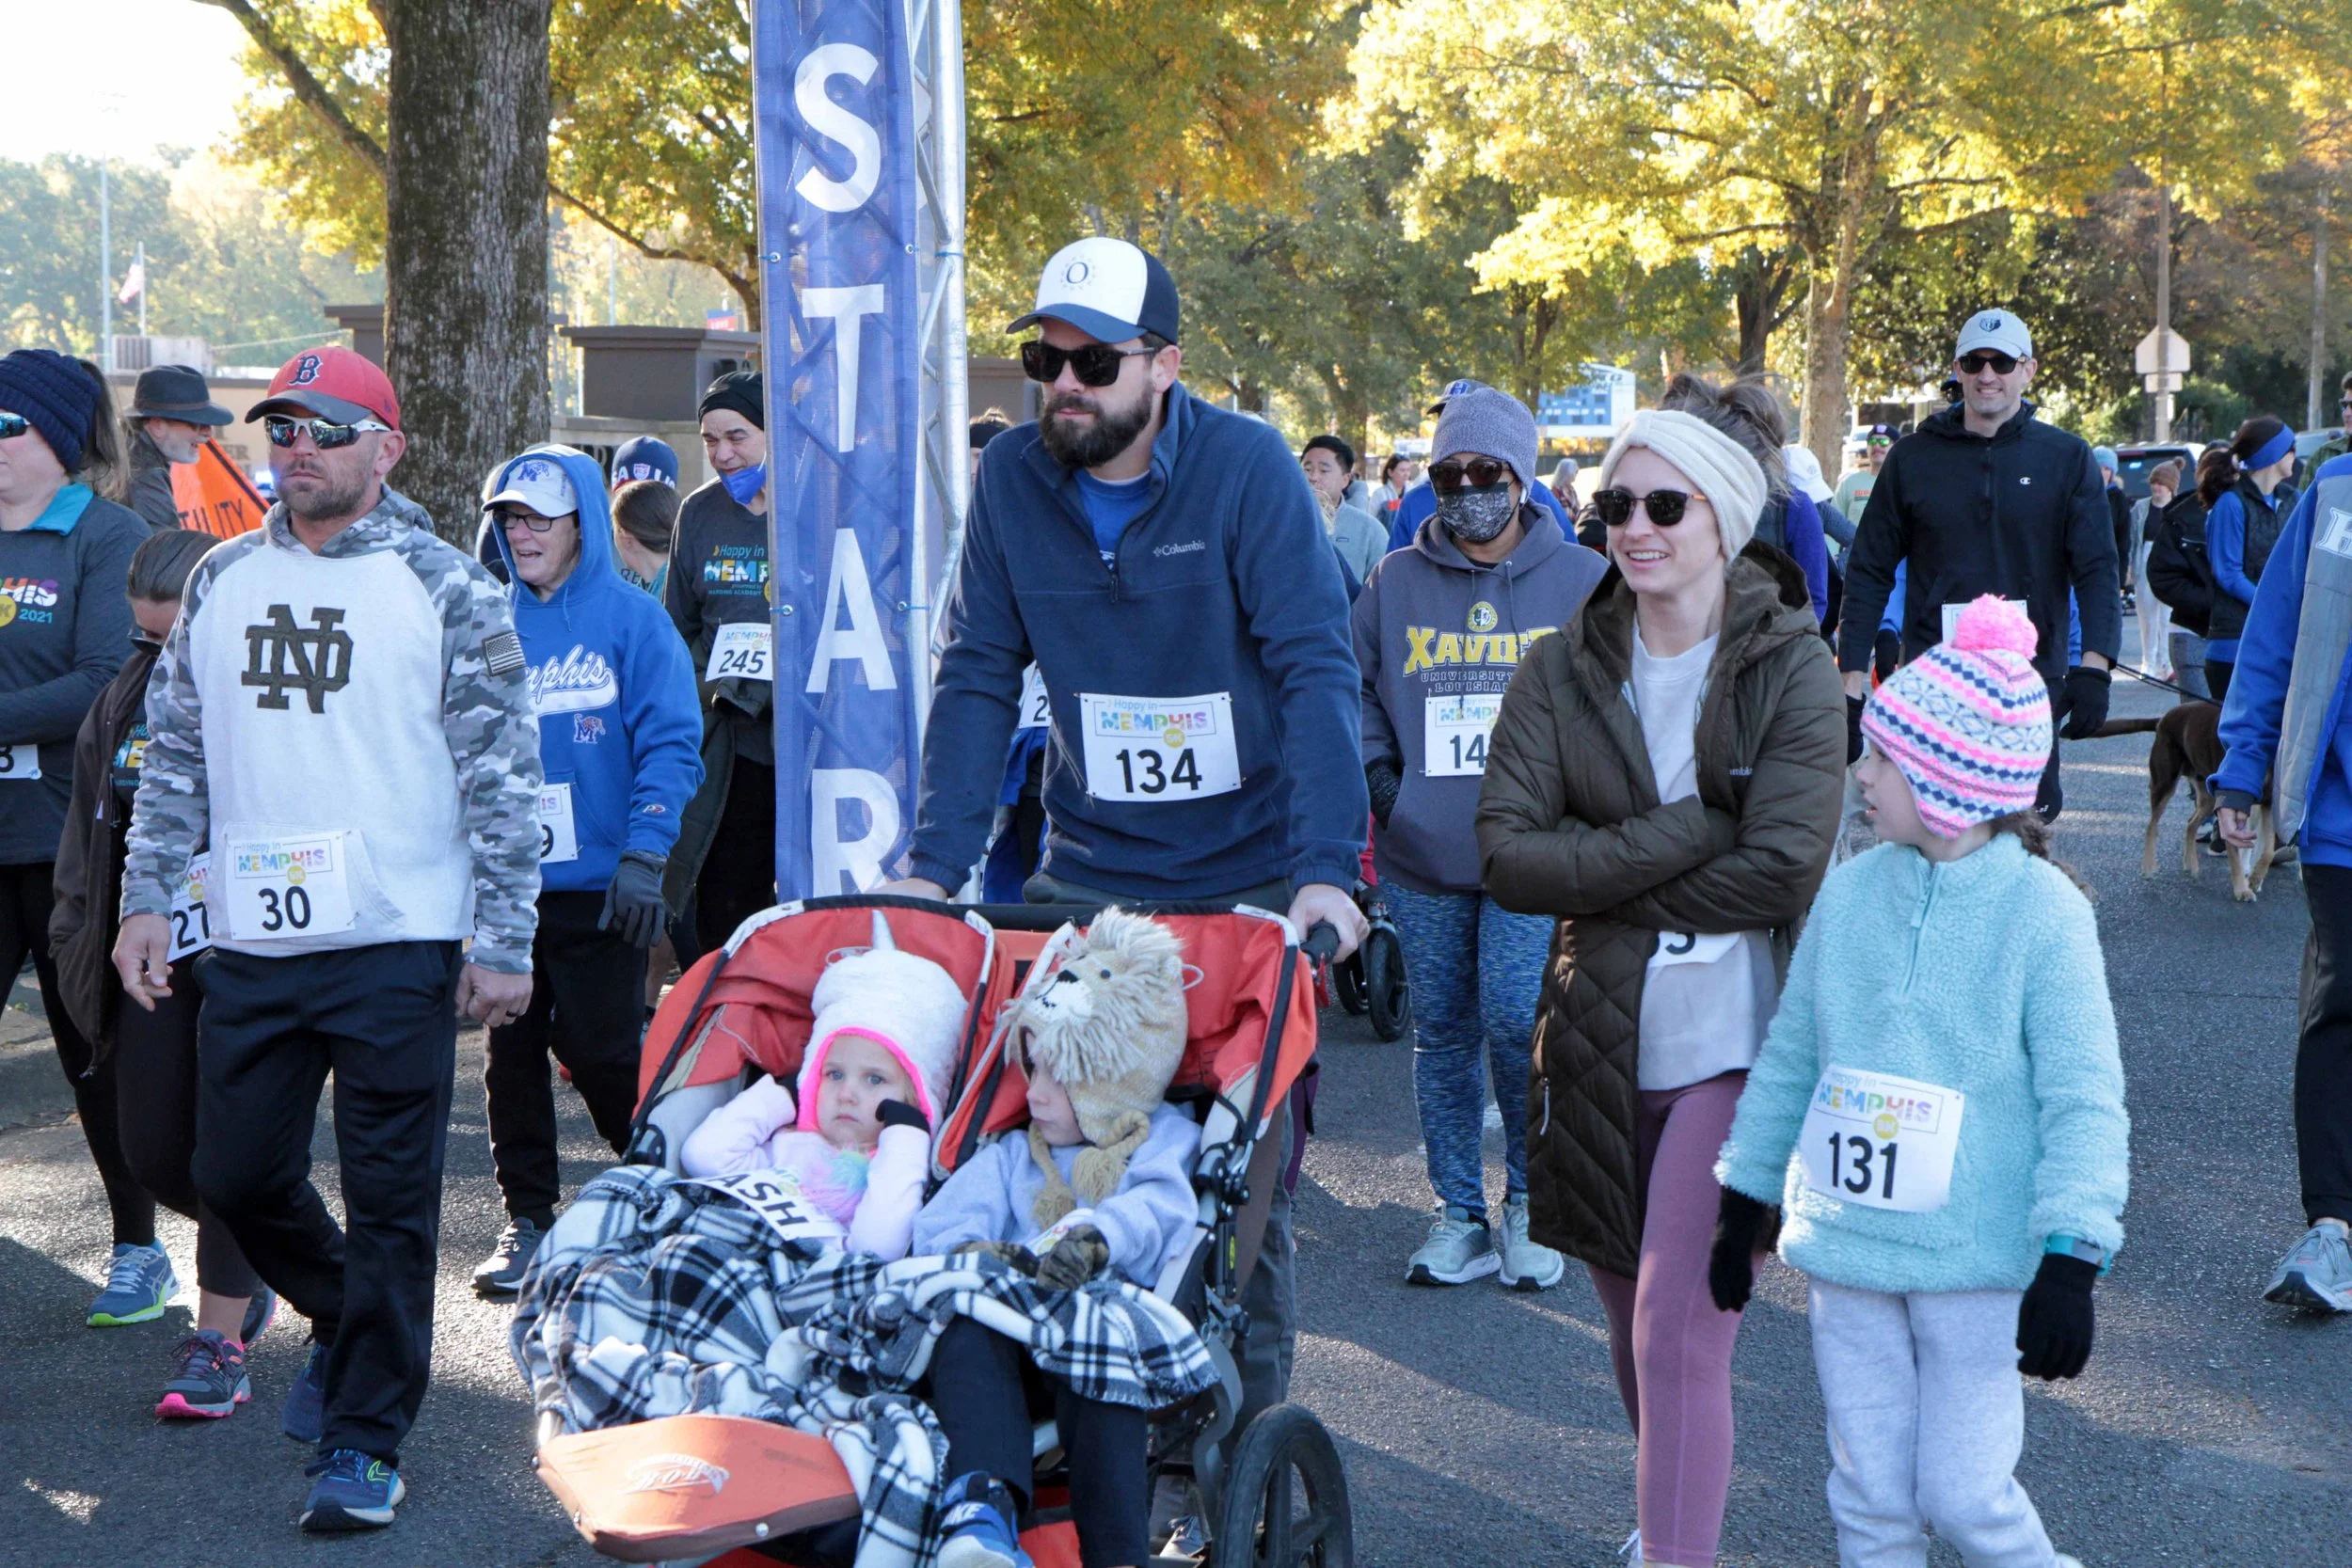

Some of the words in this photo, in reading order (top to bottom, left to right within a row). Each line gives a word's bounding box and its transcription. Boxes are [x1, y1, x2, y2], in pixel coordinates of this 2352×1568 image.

[288, 355, 324, 386] B
[719, 545, 752, 559] Happy
[754, 545, 765, 557] in
[1161, 540, 1206, 556] Columbia
[18, 608, 54, 625] 2021
[718, 649, 767, 674] 245
[1101, 710, 1209, 731] MEMPHIS
[1116, 748, 1203, 795] 134
[238, 848, 326, 873] MEMPHIS
[259, 885, 311, 932] 30
[1818, 1082, 1932, 1122] MEMPHIS
[1828, 1131, 1899, 1200] 131
